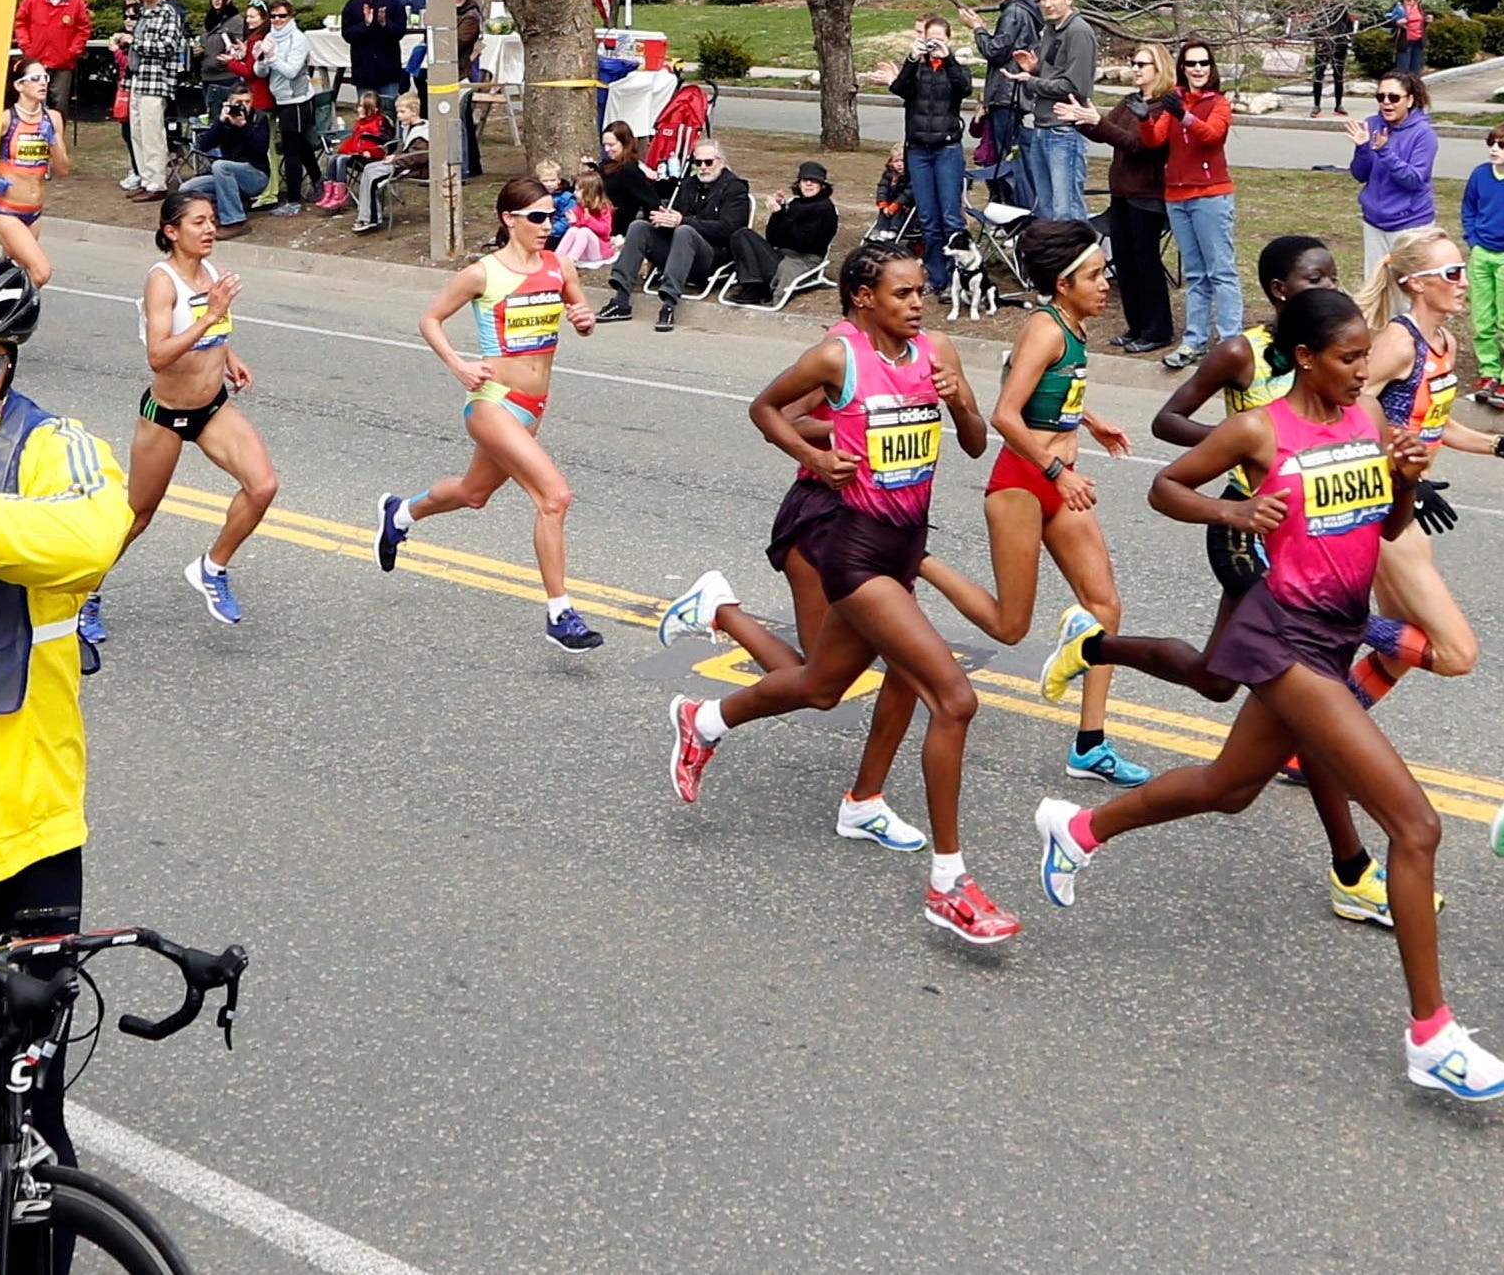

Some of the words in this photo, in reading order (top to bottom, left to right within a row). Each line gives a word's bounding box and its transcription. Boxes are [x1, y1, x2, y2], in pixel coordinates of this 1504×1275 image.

[899, 408, 939, 423] adidas
[881, 429, 931, 464] HAILU
[1314, 466, 1385, 508] DASKA
